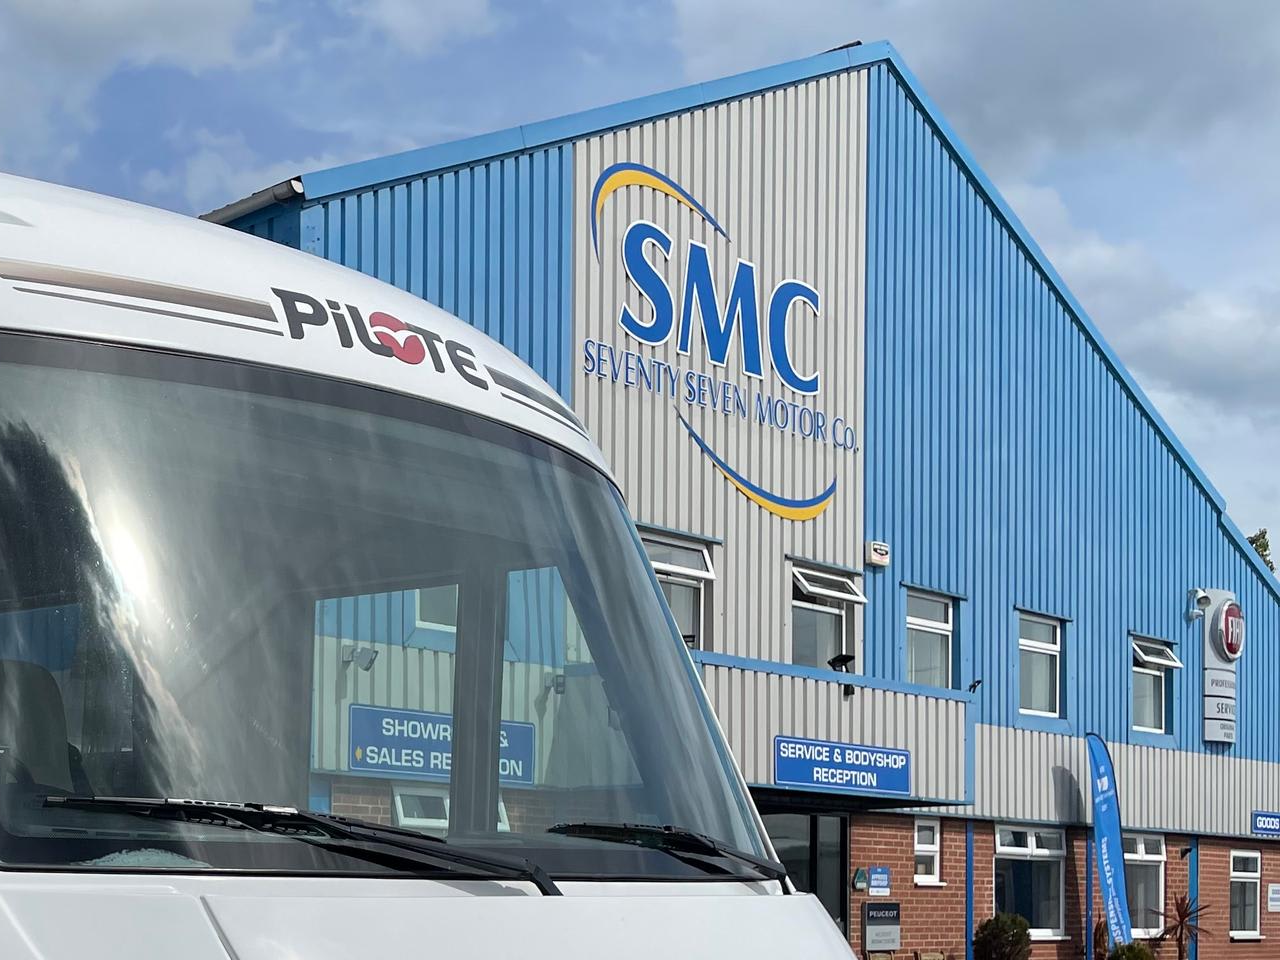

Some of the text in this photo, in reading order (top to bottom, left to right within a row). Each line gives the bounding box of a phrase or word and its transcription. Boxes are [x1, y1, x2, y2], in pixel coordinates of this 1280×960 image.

[618, 219, 820, 396] SMC
[584, 339, 680, 399] SEVENTY
[685, 372, 748, 419] SEVEN
[756, 393, 828, 442] MOTOR
[382, 718, 453, 742] SHOWR
[366, 746, 424, 769] SALES
[780, 742, 906, 769] SERVICE & BODYSHOP
[813, 767, 877, 787] RECEPTION
[1256, 816, 1280, 829] GOODS
[869, 910, 898, 918] PEUGEOT
